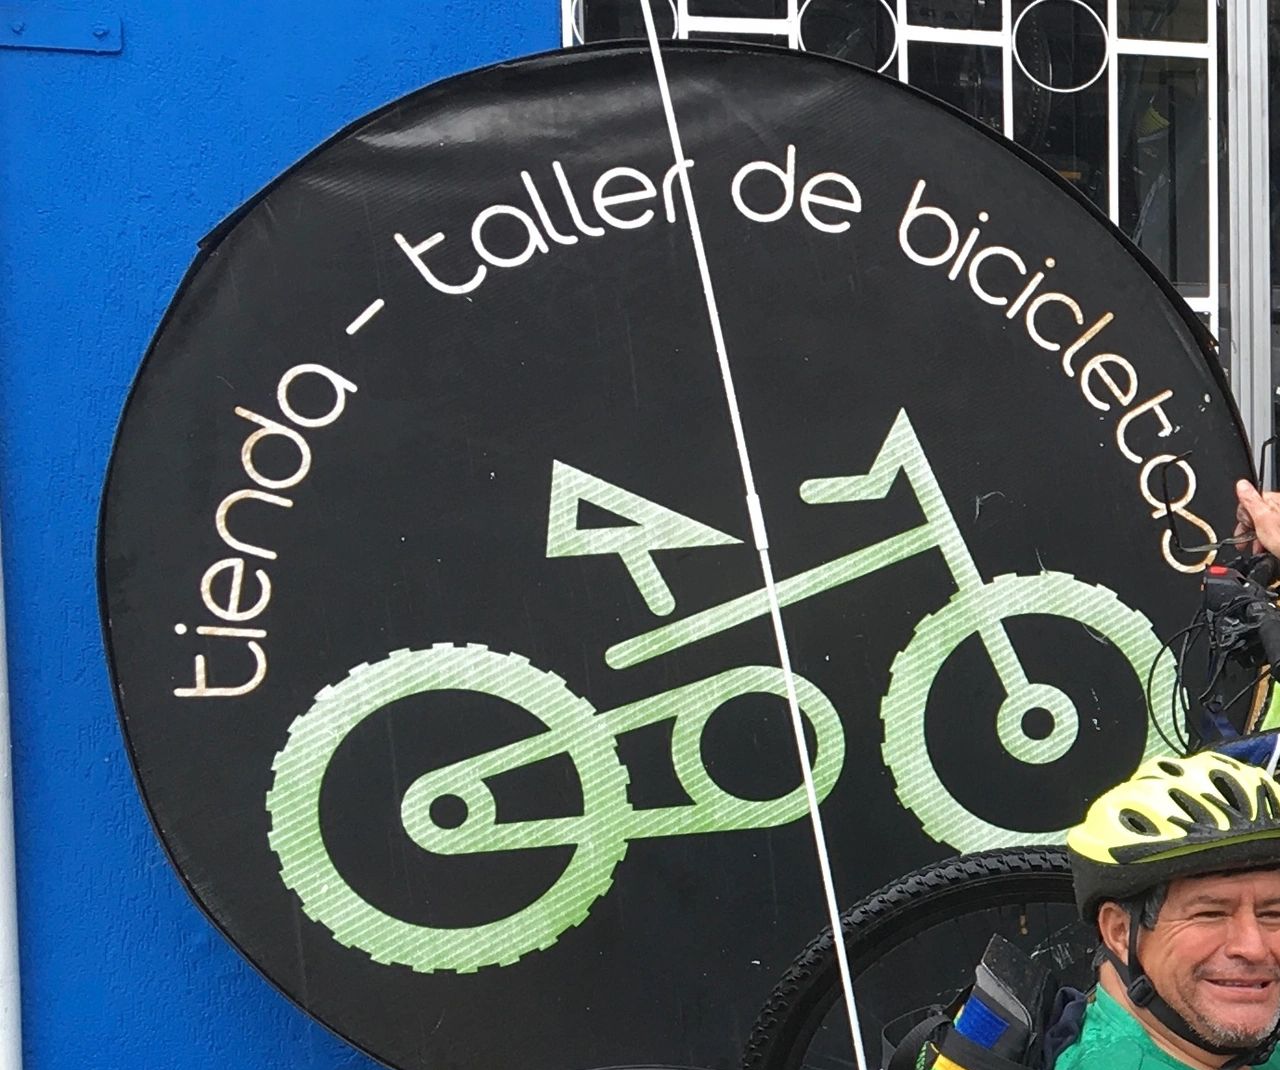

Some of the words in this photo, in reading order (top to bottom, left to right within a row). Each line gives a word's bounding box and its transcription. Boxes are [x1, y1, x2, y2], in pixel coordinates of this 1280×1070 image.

[173, 362, 358, 698] tienda
[393, 159, 693, 295] taller
[731, 144, 862, 234] de
[898, 179, 1219, 574] bicicletas
